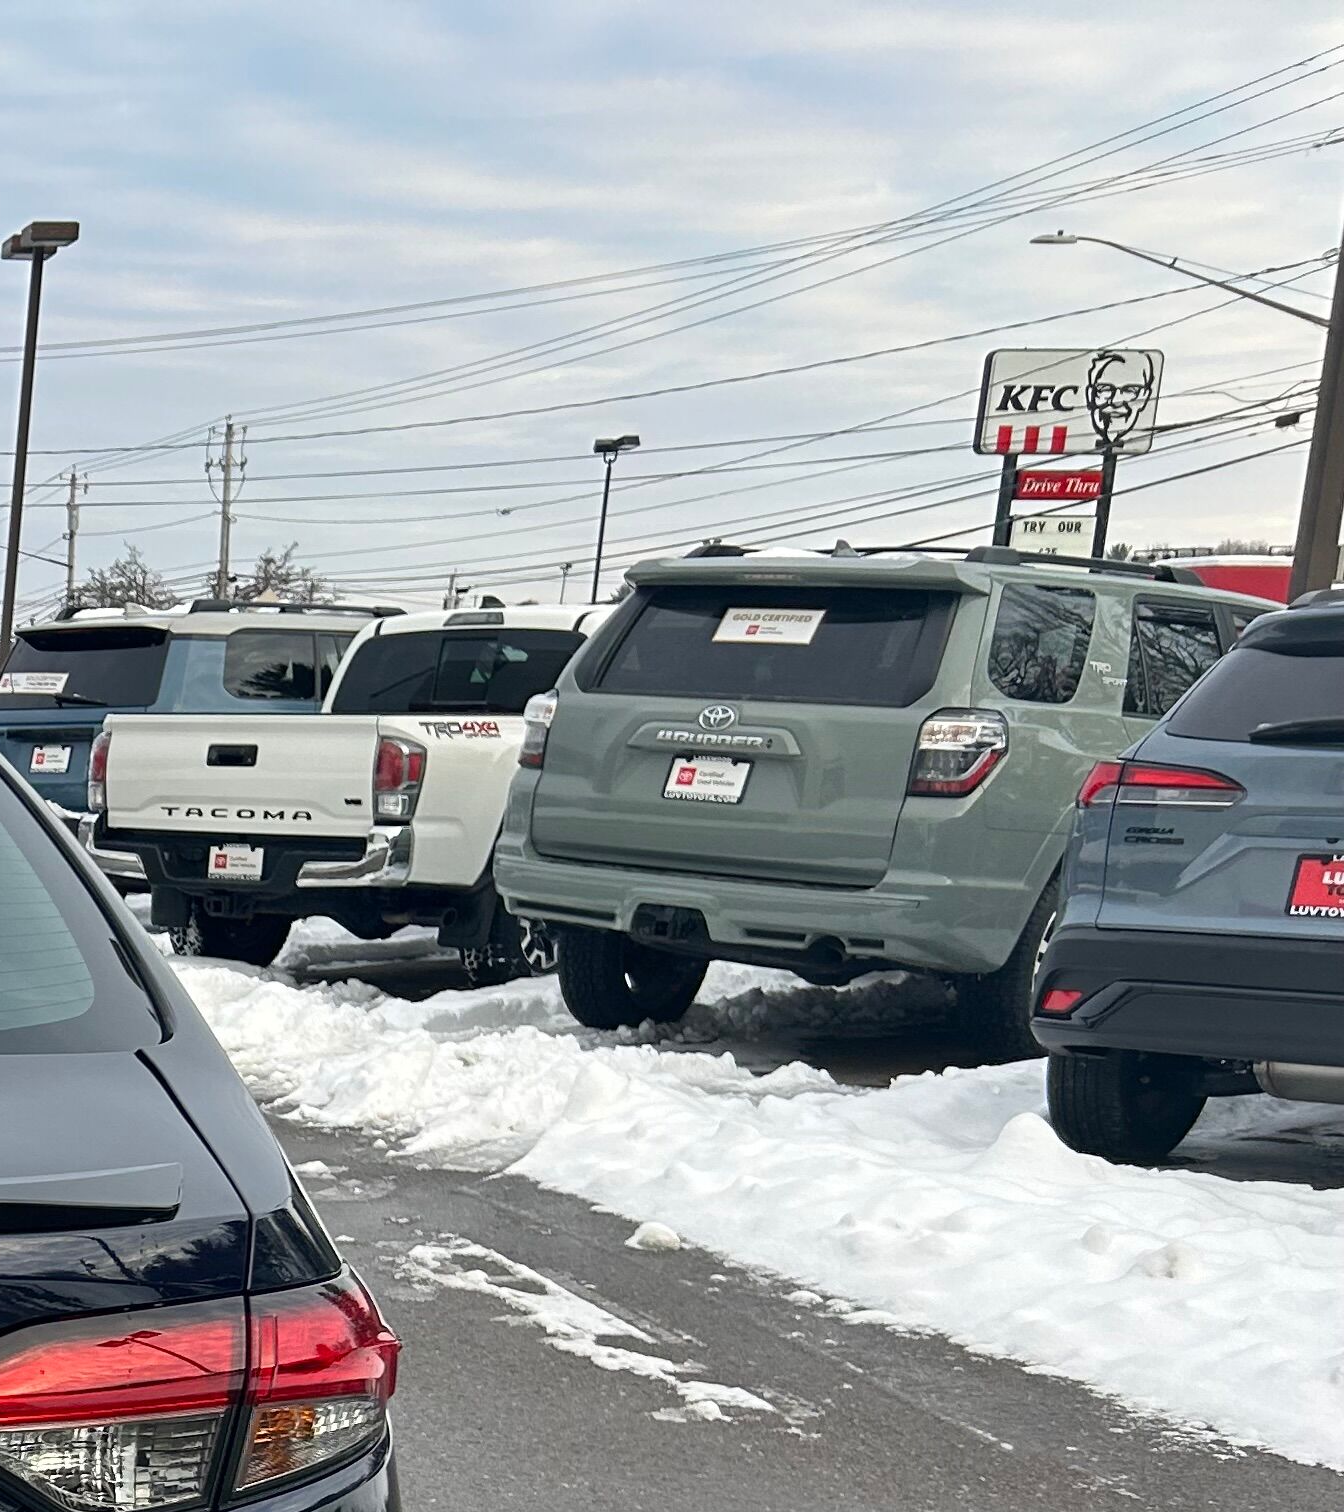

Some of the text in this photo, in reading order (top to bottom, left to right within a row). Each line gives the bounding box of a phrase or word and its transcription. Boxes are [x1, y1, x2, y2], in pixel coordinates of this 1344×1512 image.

[995, 385, 1080, 412] KFC
[1021, 477, 1100, 494] Drive Thru
[1023, 521, 1082, 534] TRY OUR
[732, 613, 813, 623] GOLD CERTIFIED
[160, 806, 312, 821] TACOMA
